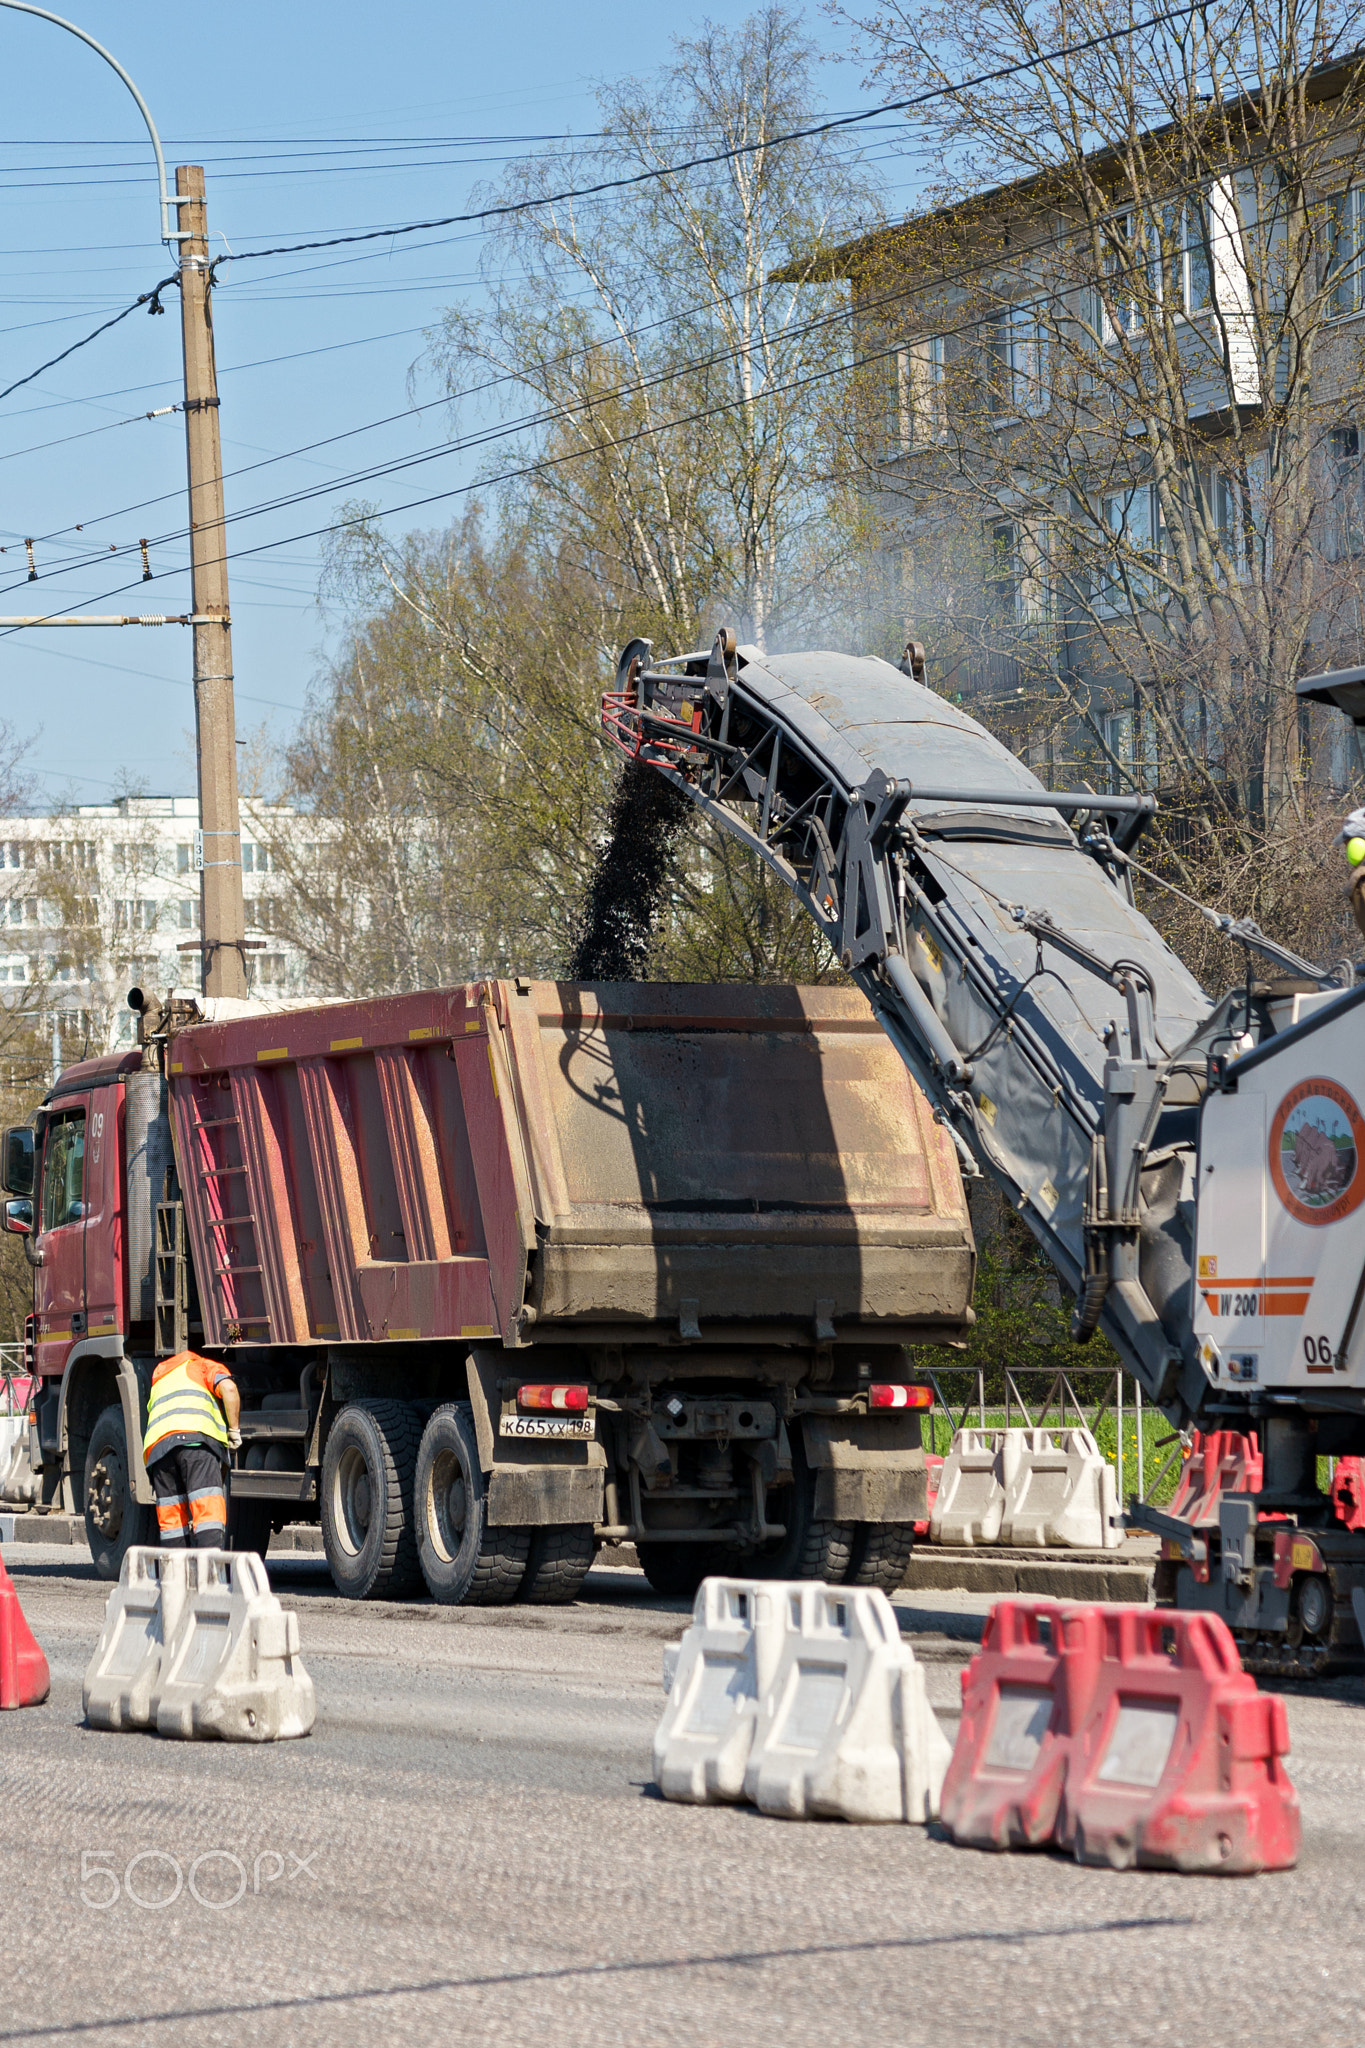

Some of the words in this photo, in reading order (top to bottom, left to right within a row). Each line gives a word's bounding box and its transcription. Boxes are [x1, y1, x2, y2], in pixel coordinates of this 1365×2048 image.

[195, 832, 203, 867] 136
[92, 1112, 104, 1138] 09
[1221, 1294, 1232, 1316] W
[1234, 1294, 1257, 1317] 200
[1303, 1335, 1333, 1364] 06
[569, 1420, 591, 1434] 198
